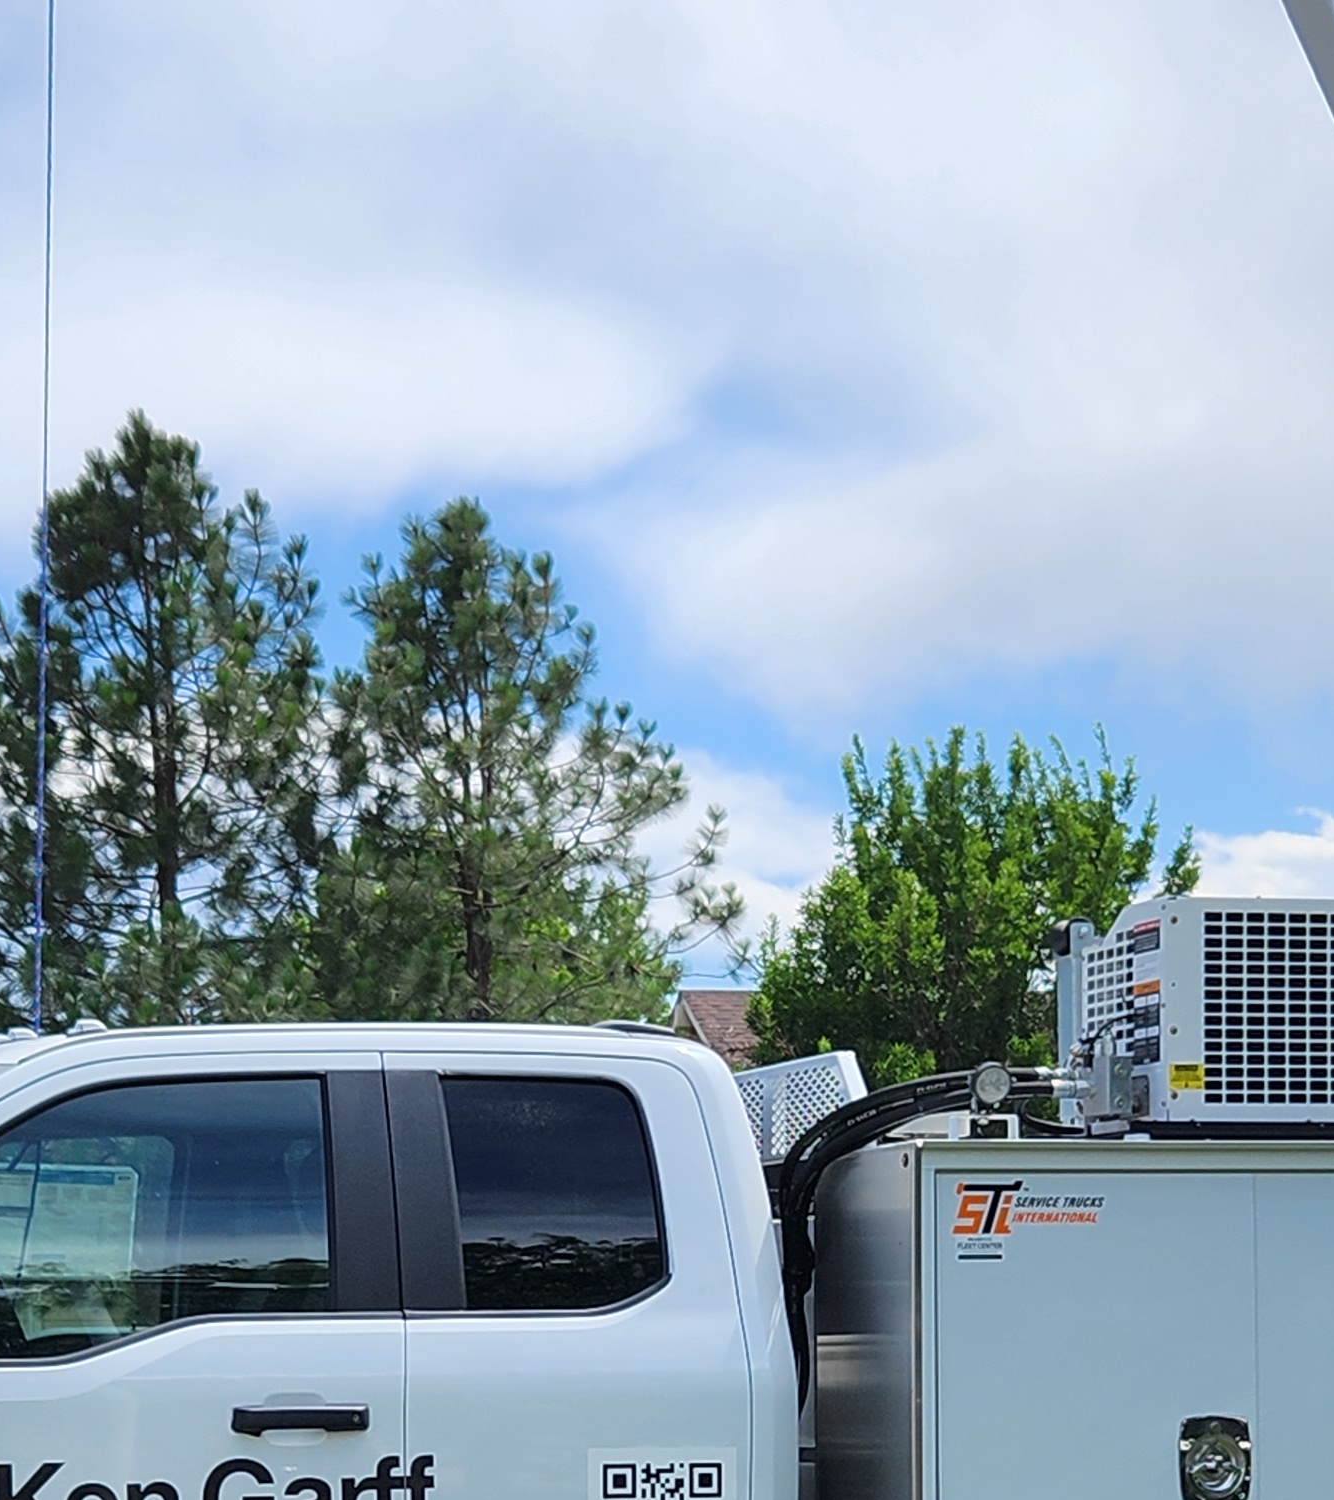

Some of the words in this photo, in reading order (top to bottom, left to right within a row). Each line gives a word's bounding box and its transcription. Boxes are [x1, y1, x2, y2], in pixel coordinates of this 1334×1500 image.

[1014, 1196, 1059, 1208] SERVICE
[1062, 1196, 1105, 1208] TRUCKS
[1012, 1212, 1098, 1223] INTERNATIONAL
